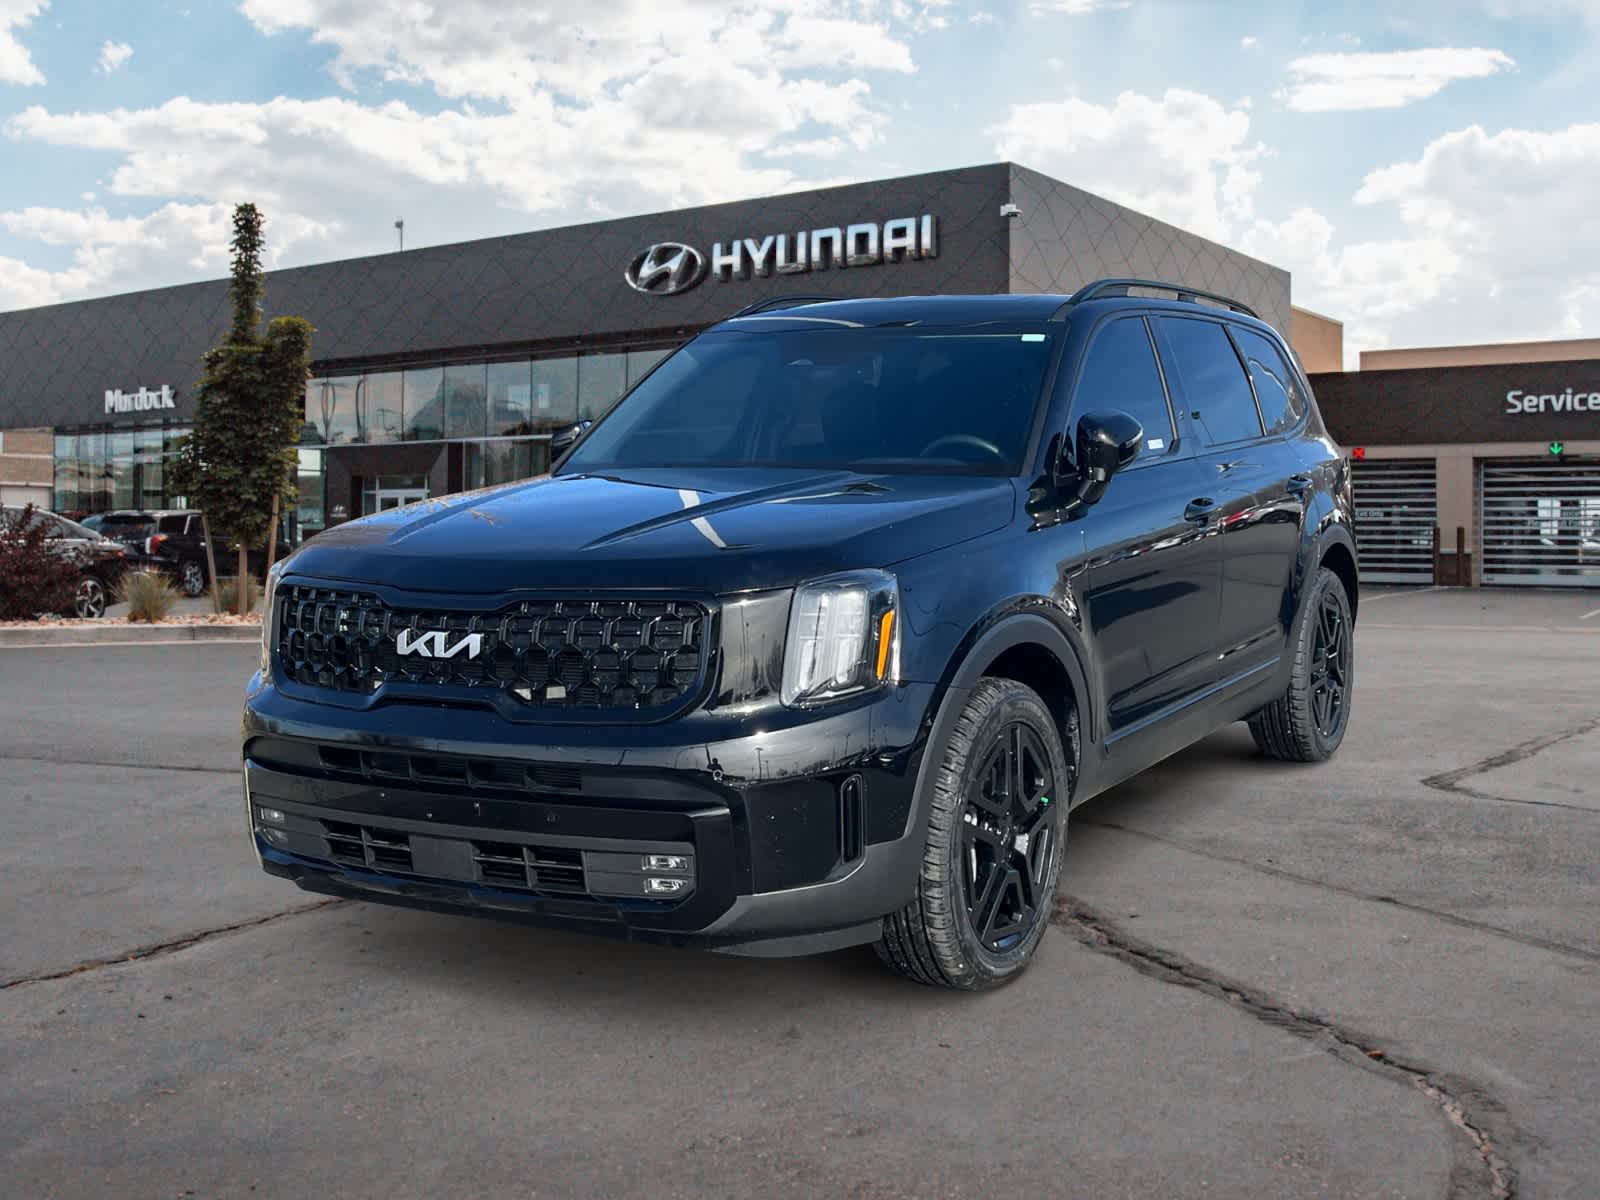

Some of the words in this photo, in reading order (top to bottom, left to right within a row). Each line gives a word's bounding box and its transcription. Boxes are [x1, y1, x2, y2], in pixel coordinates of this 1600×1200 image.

[711, 214, 937, 281] HYUNDAI
[104, 384, 176, 414] Murdock
[1505, 387, 1600, 413] Service
[396, 628, 484, 660] KIA
